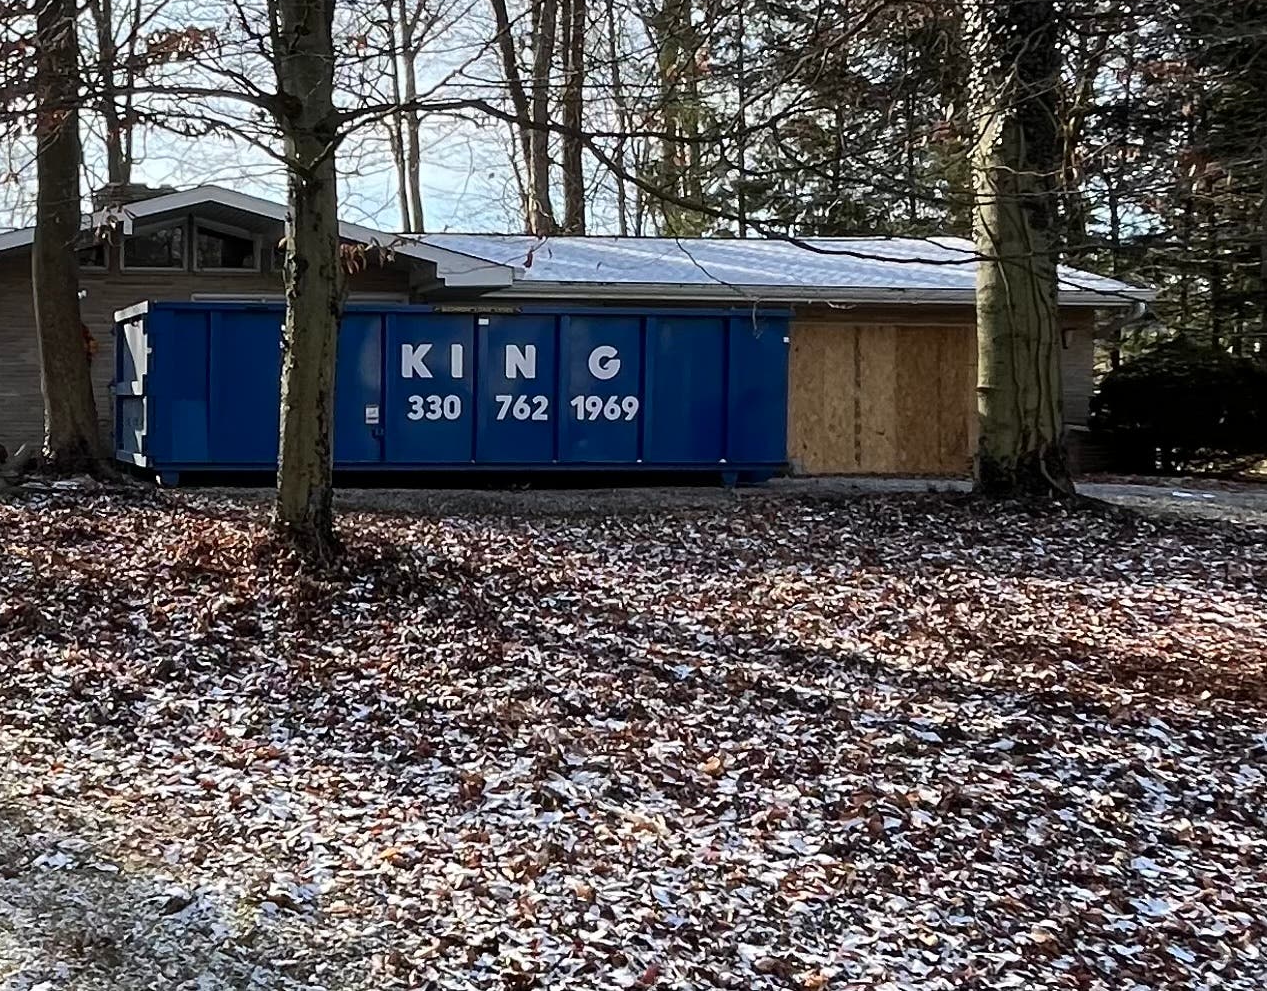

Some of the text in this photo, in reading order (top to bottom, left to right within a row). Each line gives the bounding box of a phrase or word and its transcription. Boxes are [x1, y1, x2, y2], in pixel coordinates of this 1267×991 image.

[407, 394, 461, 421] 330
[495, 394, 549, 421] 762
[570, 395, 640, 421] 1969
